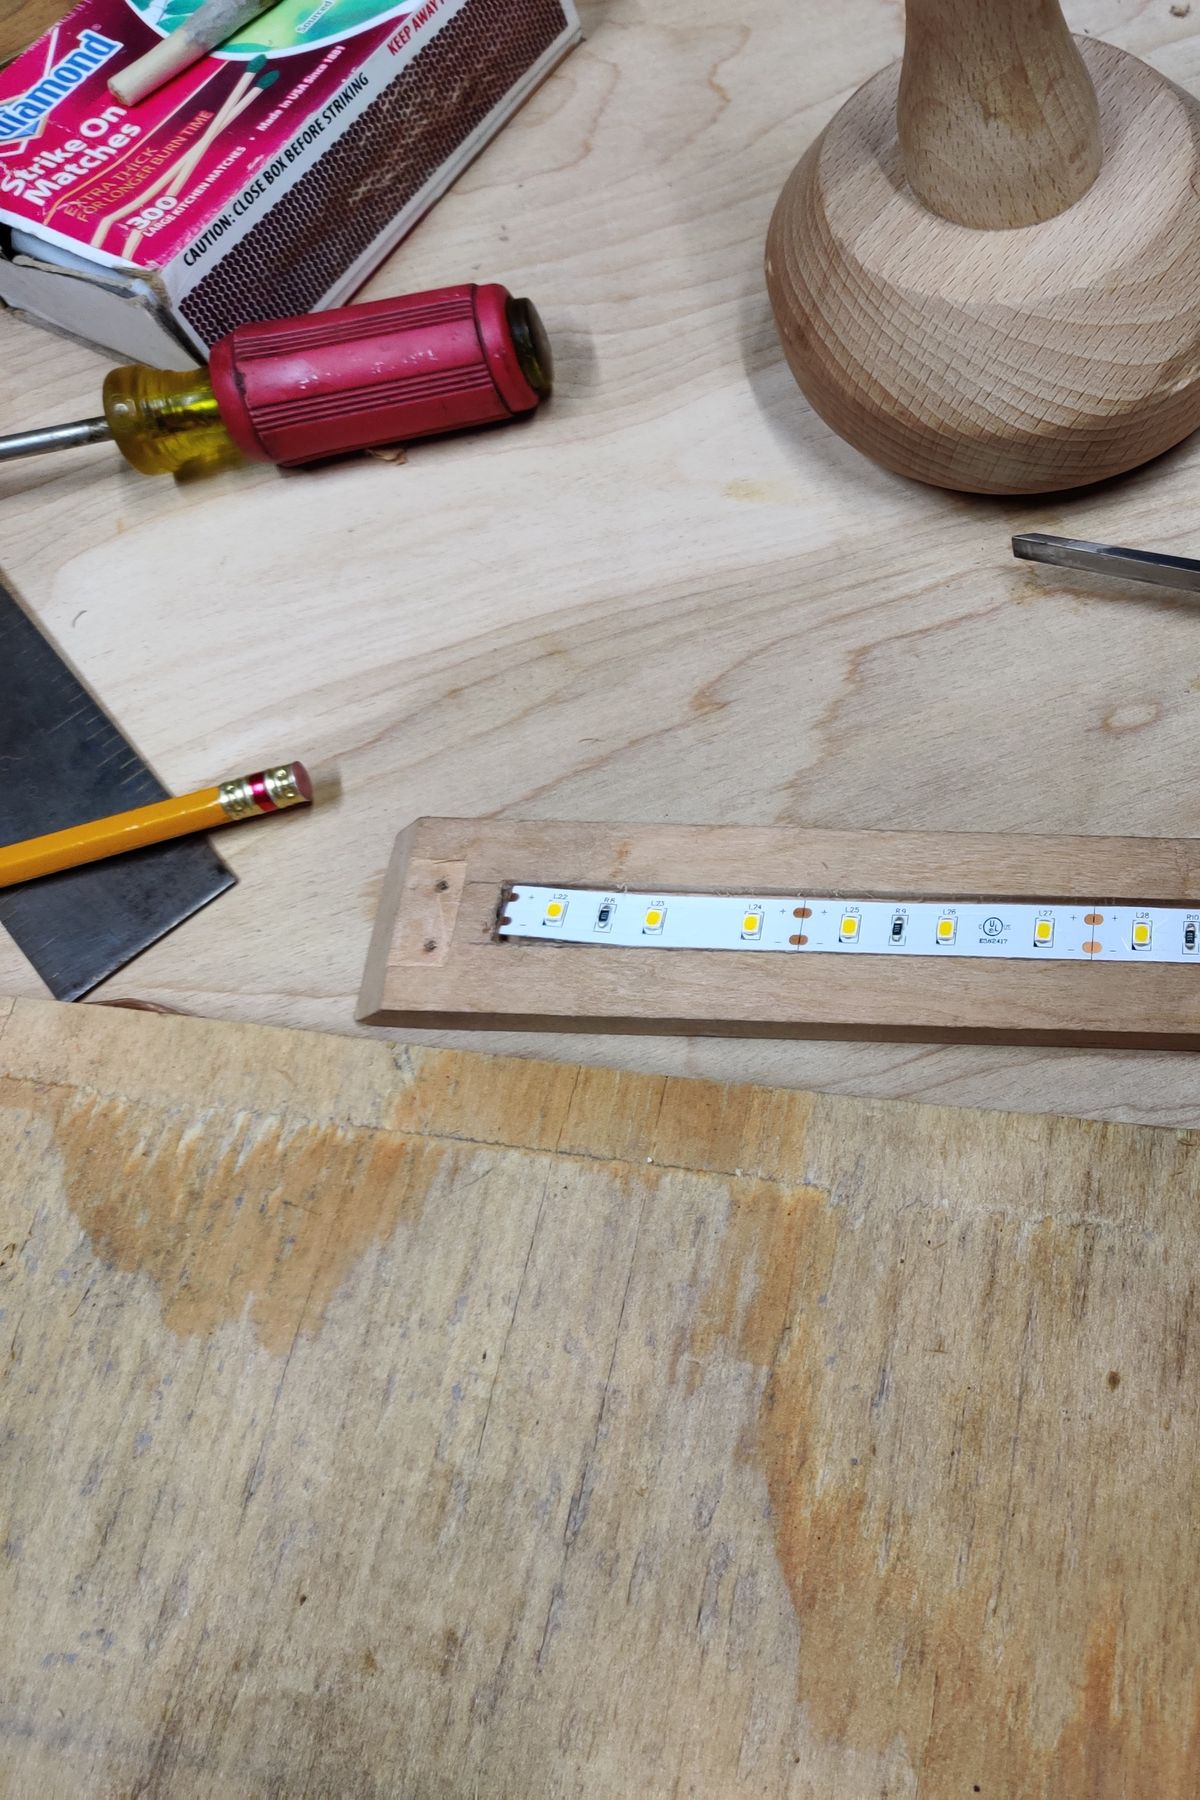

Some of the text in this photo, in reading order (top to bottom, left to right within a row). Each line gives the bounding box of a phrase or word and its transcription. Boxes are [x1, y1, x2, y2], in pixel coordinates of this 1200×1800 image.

[387, 26, 412, 56] KEEP
[256, 109, 283, 132] Made
[289, 82, 309, 103] USA
[304, 62, 329, 86] Since
[1, 106, 127, 196] Strike On
[23, 123, 141, 206] Matches
[64, 147, 158, 217] EXTRA THICK
[78, 110, 216, 223] FOR LONGER BURN TIME
[143, 146, 246, 237] LARGE KITCHEN MATCHES
[183, 72, 369, 267] CAUTION: CLOSE BOX BEFORE STRIKING
[125, 195, 178, 231] 300
